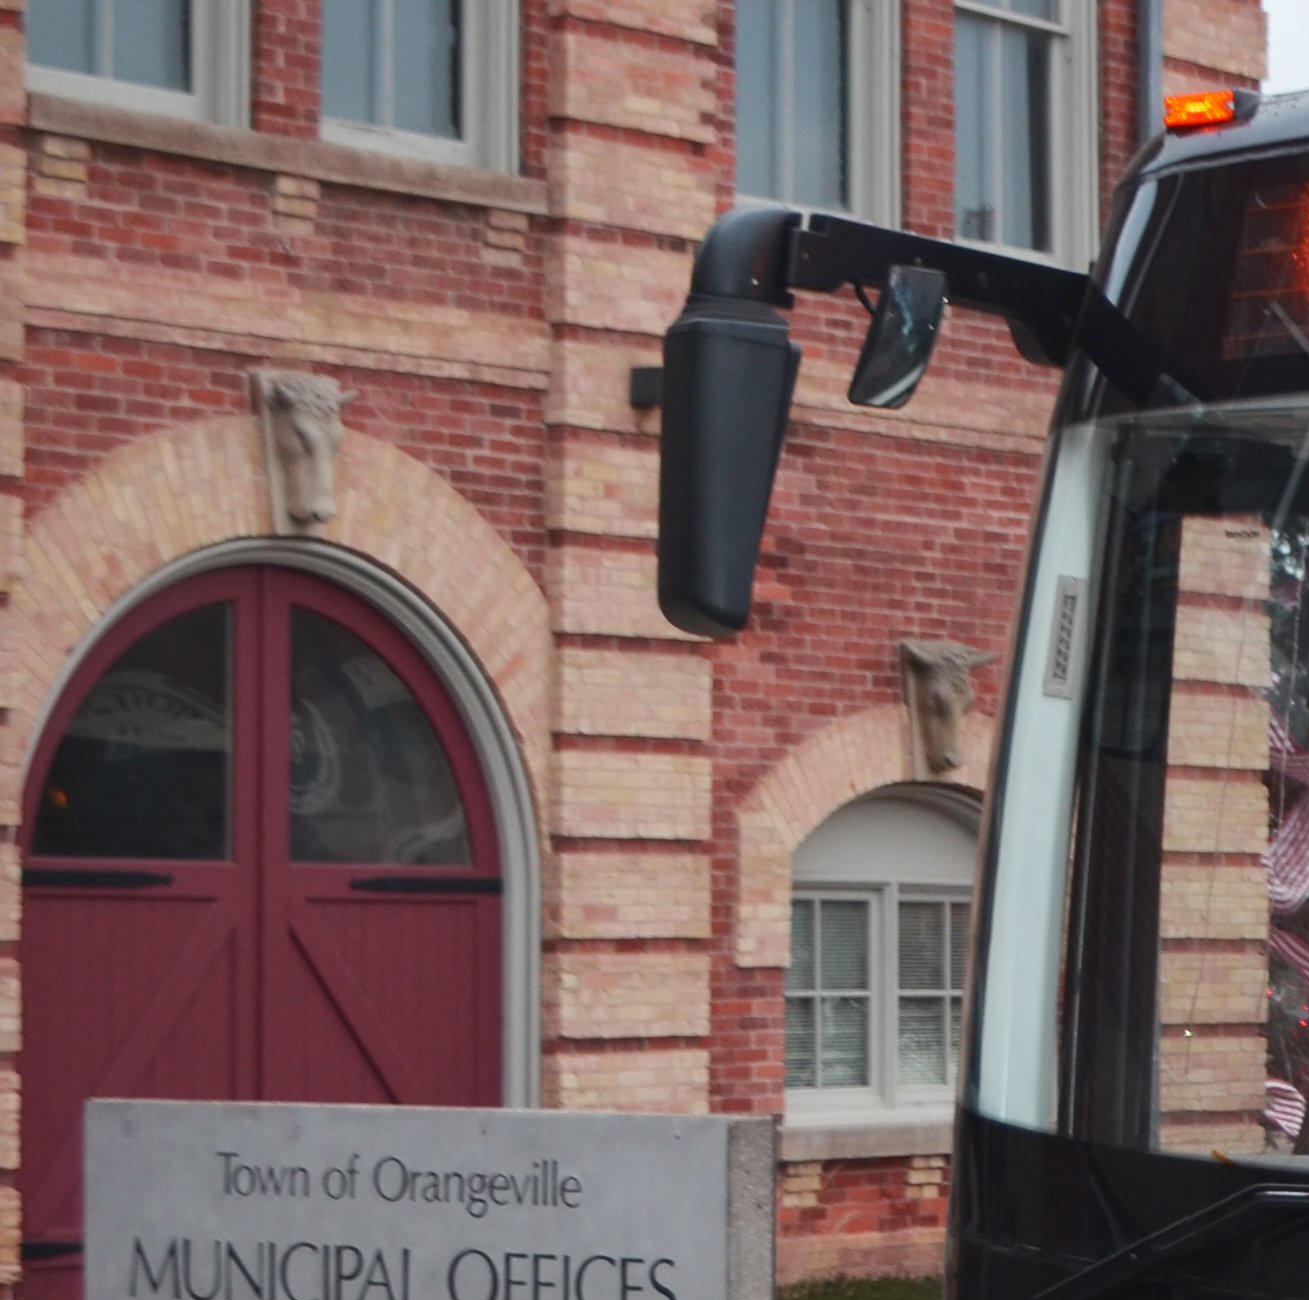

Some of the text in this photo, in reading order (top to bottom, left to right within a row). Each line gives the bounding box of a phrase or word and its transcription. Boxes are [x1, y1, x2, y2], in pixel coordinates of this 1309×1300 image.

[217, 1151, 583, 1218] Town of Orangeville
